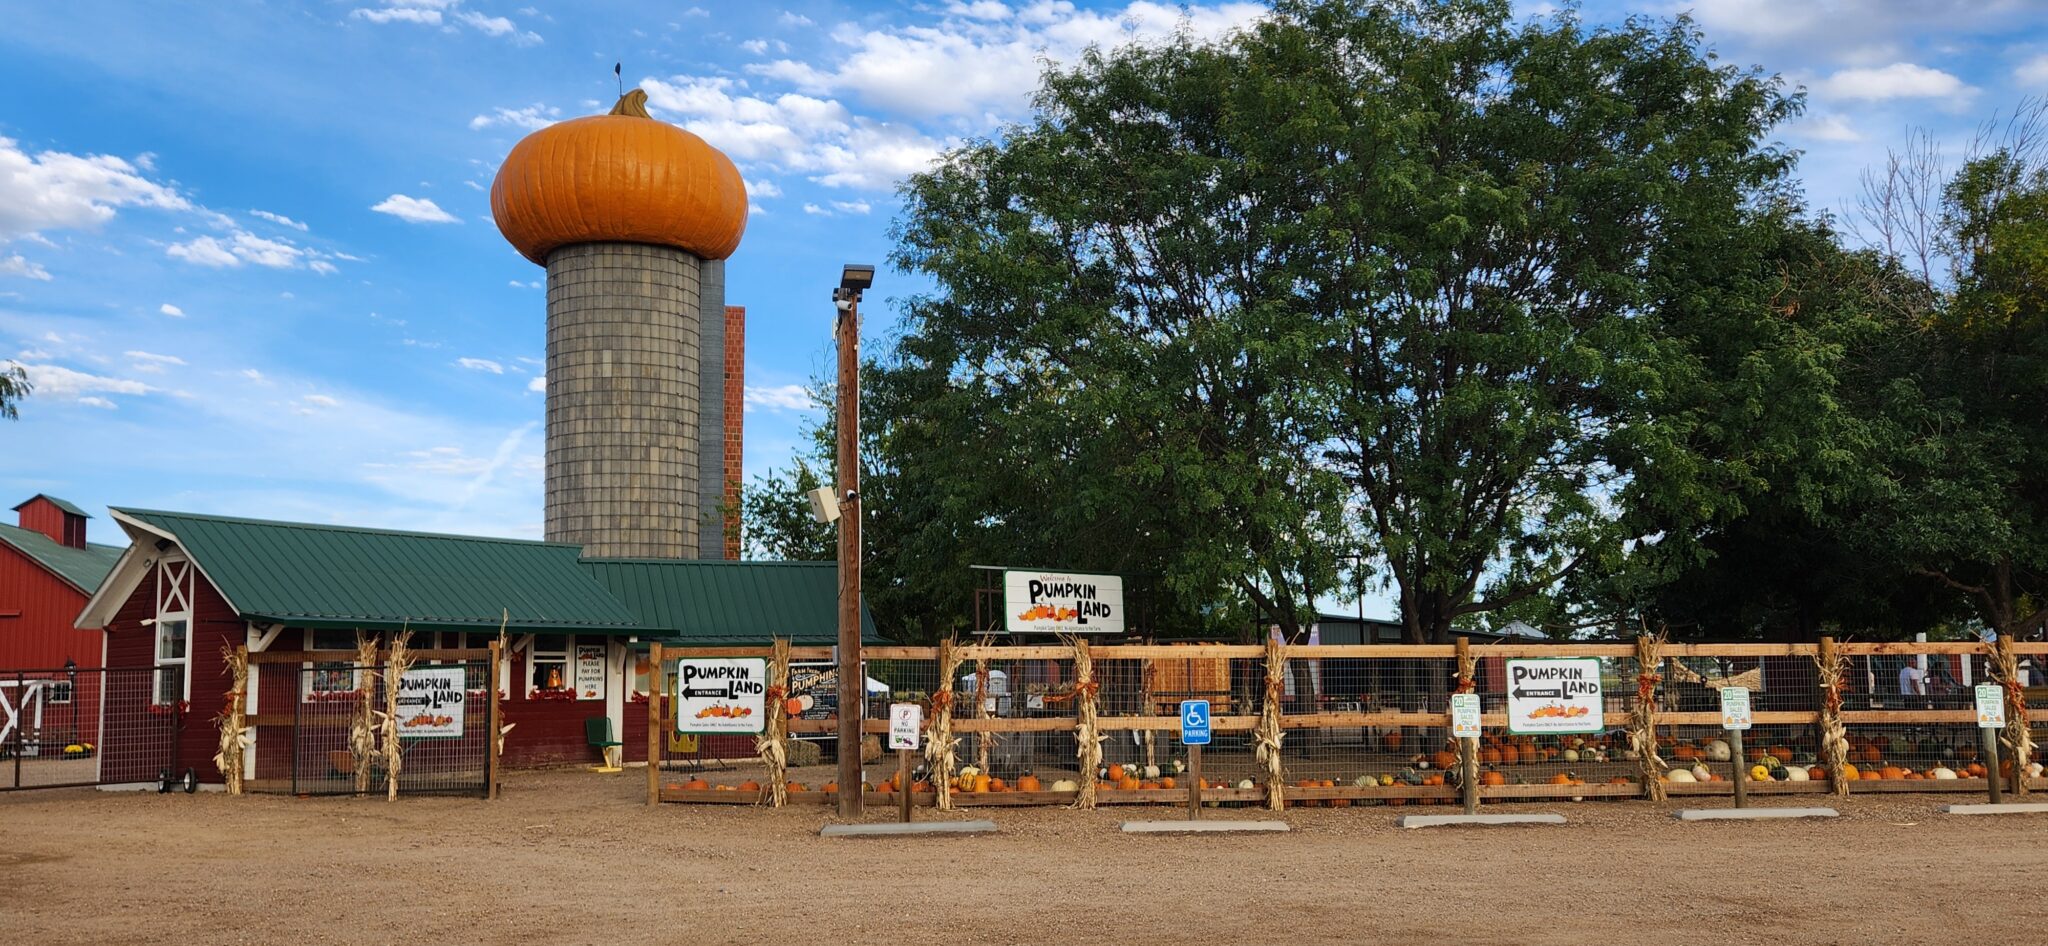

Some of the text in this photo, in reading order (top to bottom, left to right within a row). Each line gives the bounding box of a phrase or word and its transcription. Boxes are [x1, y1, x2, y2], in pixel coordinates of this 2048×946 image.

[1040, 574, 1065, 582] Welcome
[1029, 580, 1096, 604] PUMPKIN
[1077, 601, 1111, 624] LAND
[683, 665, 749, 684] PUMPKIN
[1513, 666, 1582, 685] PUMPKIN
[433, 690, 463, 708] LAND
[729, 681, 763, 699] LAND
[1562, 681, 1598, 699] LAND
[1723, 690, 1732, 700] 20
[1978, 688, 1987, 697] 20
[1454, 696, 1463, 707] 20
[1185, 729, 1208, 738] PARKING
